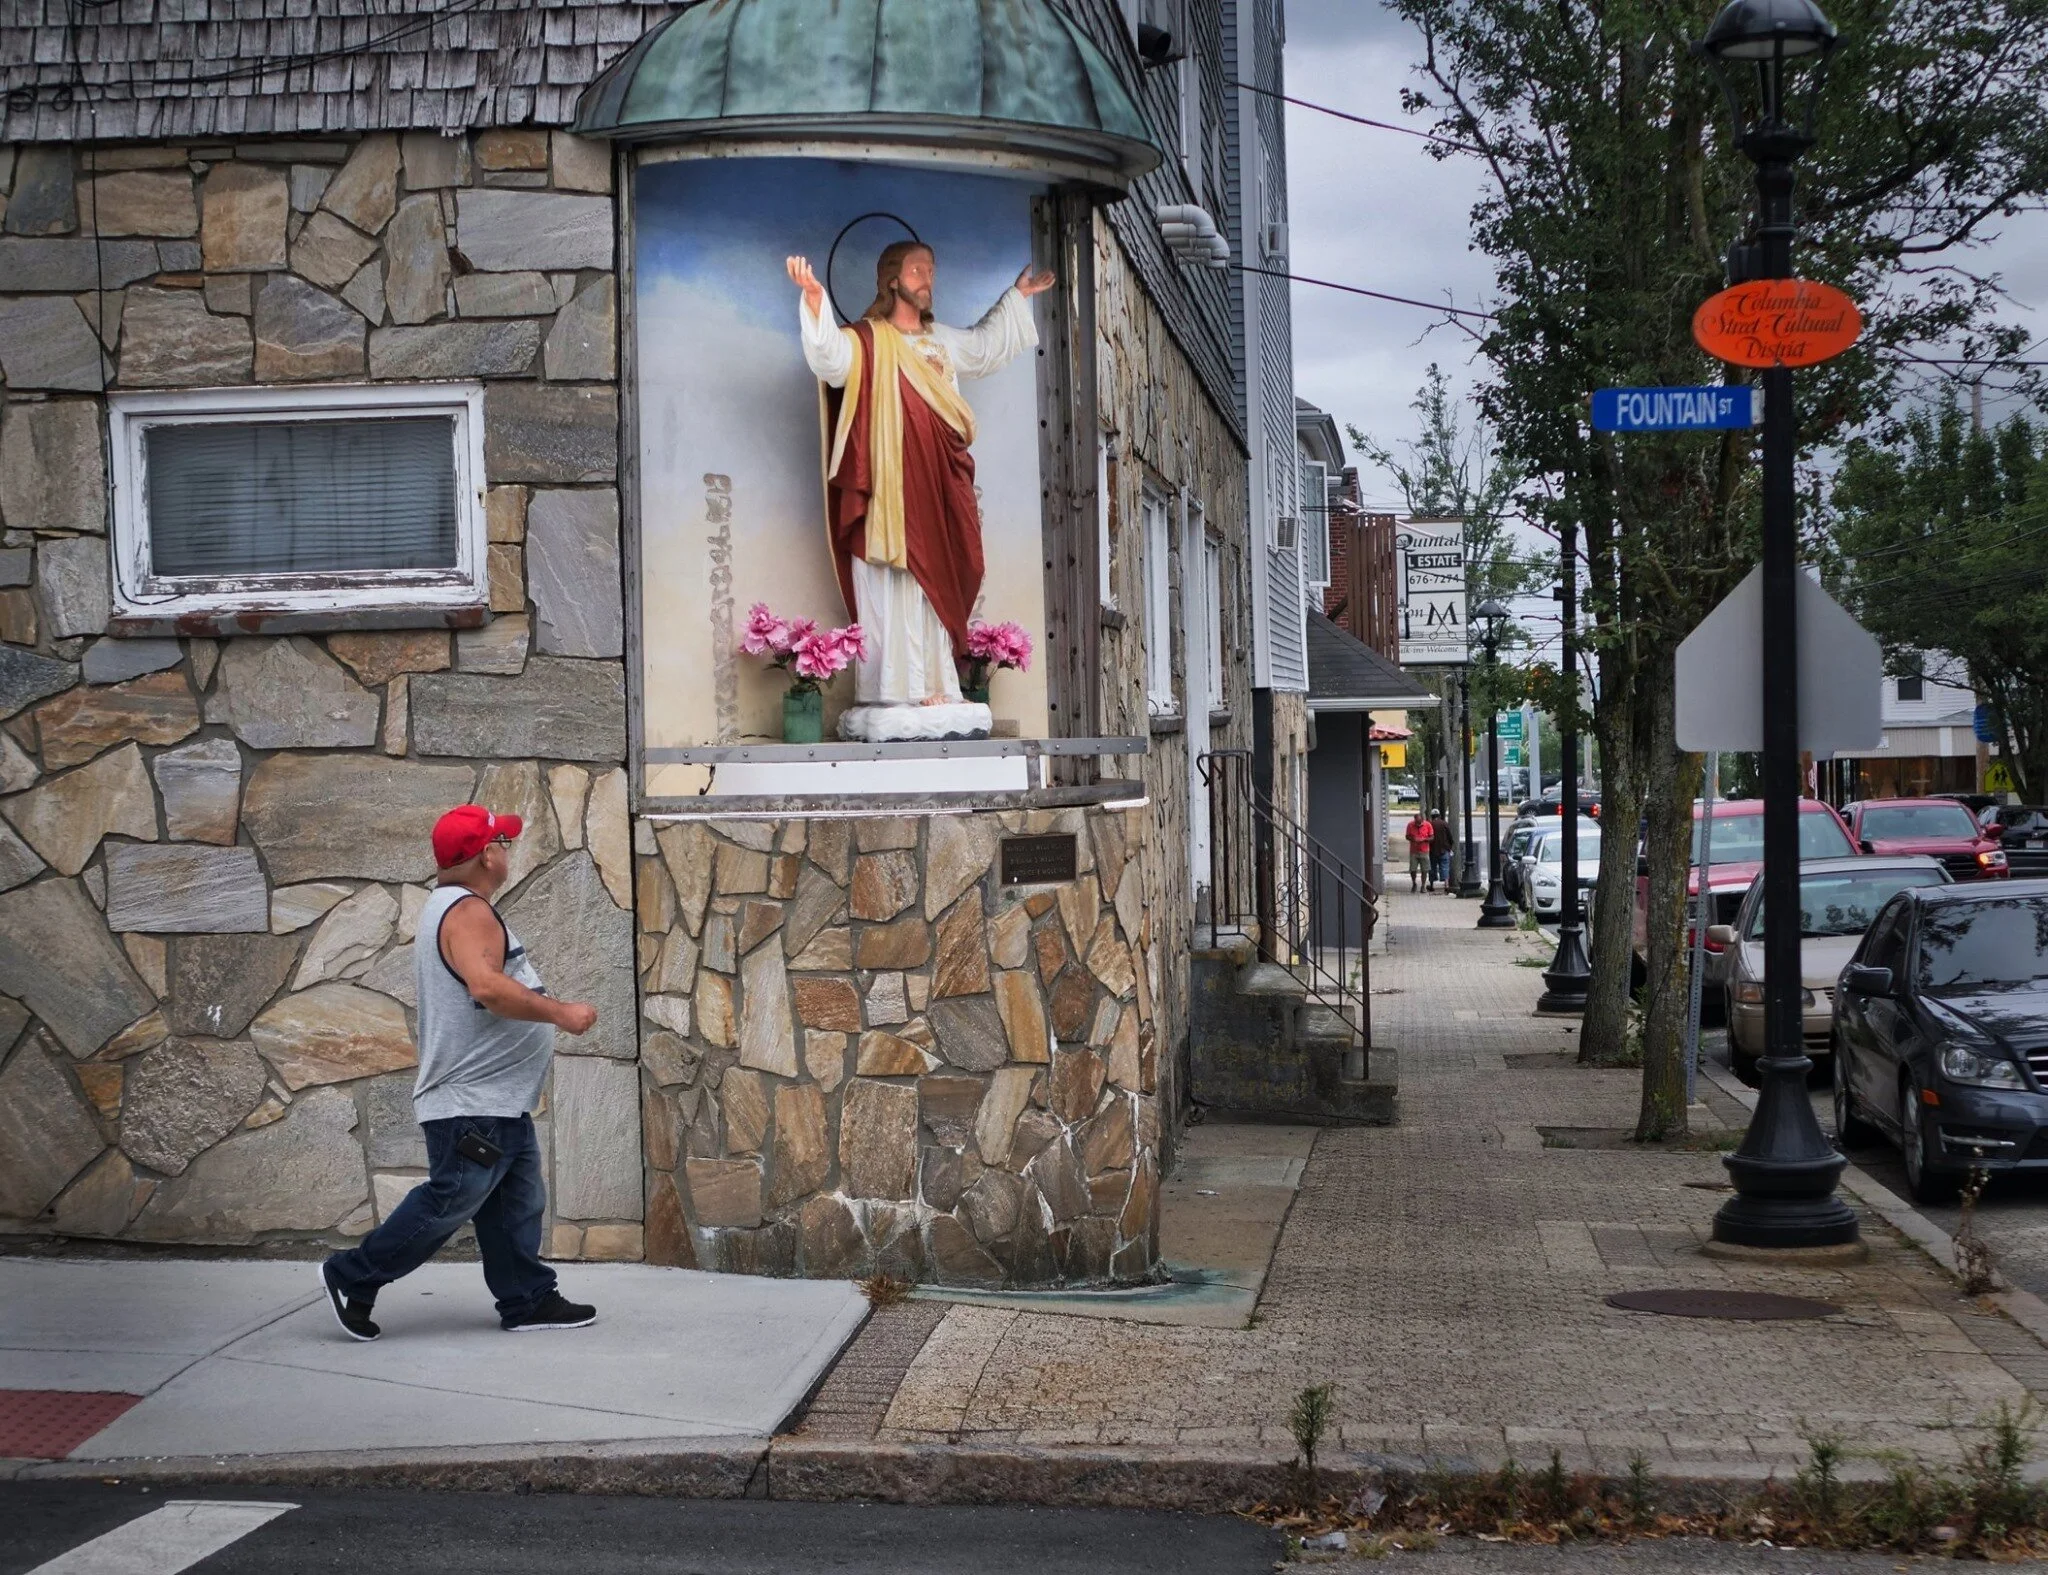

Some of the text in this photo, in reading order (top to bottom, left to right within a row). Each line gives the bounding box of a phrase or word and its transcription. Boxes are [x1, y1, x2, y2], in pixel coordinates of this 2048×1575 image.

[1726, 287, 1826, 315] Columbia
[1702, 309, 1846, 338] Street Cultural
[1736, 336, 1807, 358] District
[1616, 391, 1734, 426] FOUNTAIN ST
[1396, 533, 1461, 552] Quintal
[1417, 555, 1458, 567] ESTATE
[1409, 574, 1460, 585] 676-7274
[1426, 645, 1459, 654] Welcome
